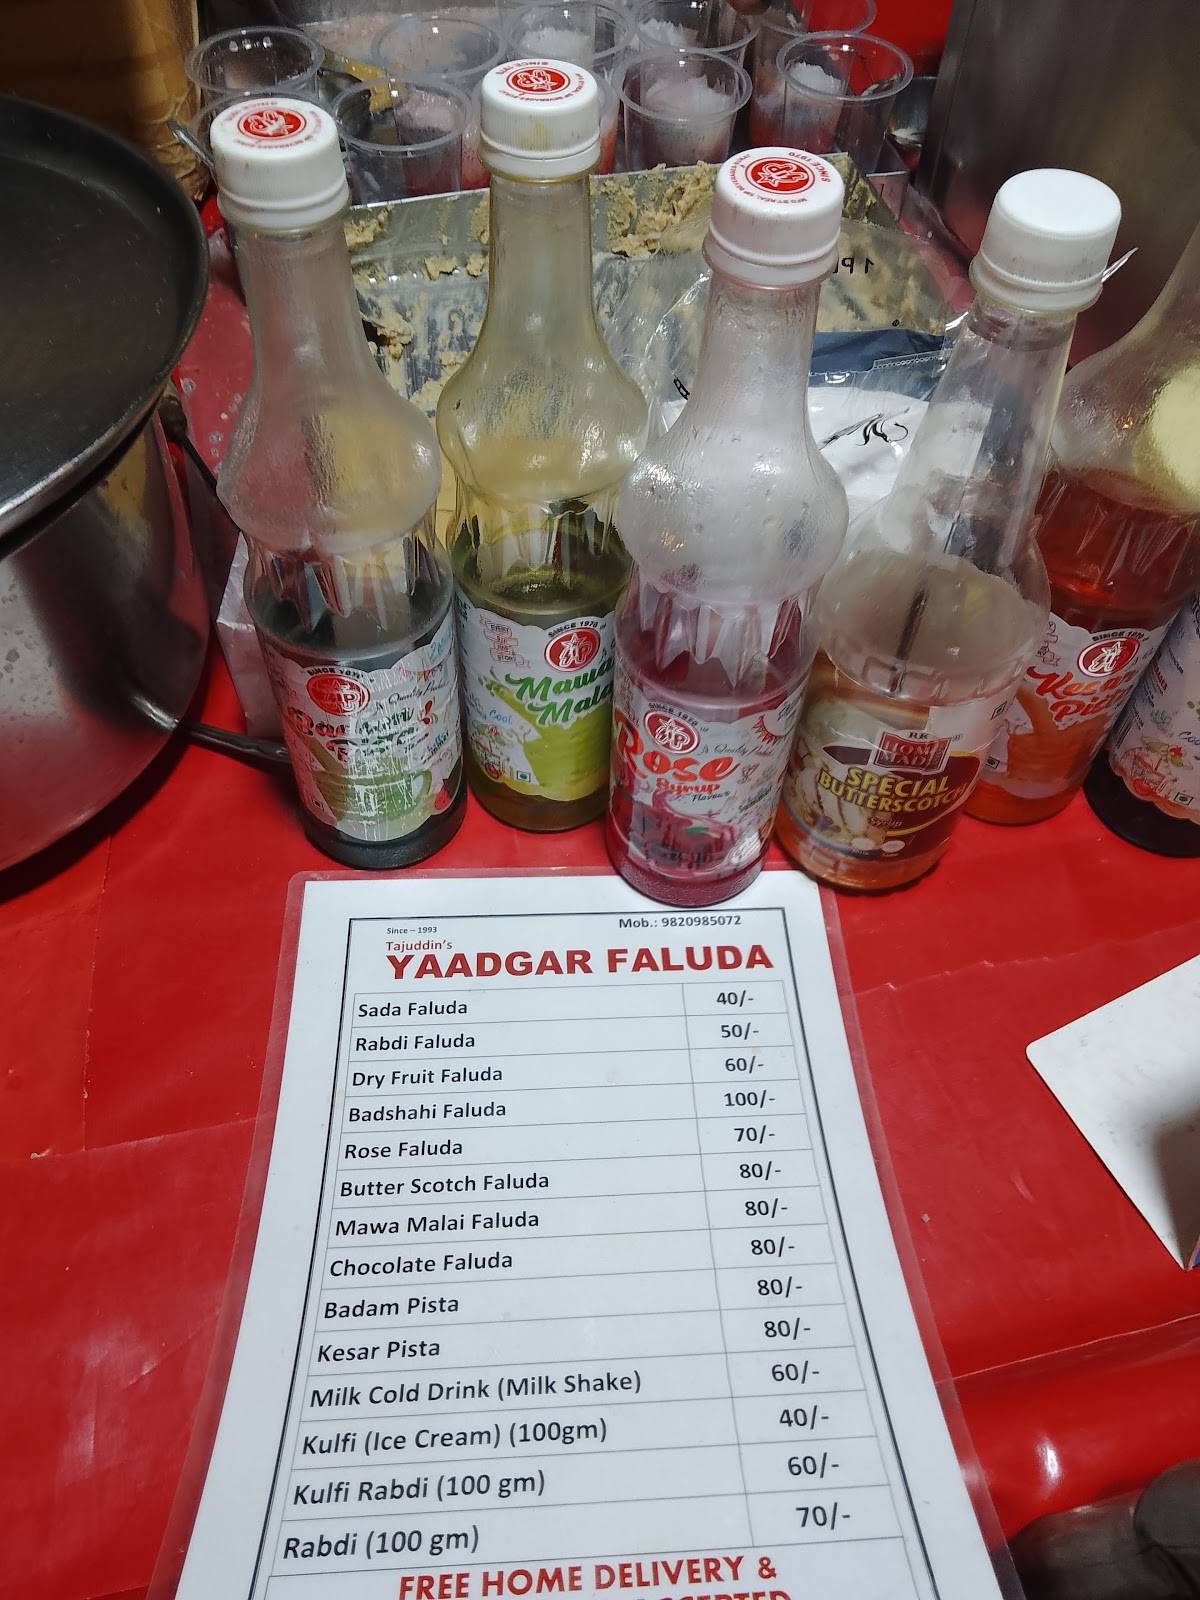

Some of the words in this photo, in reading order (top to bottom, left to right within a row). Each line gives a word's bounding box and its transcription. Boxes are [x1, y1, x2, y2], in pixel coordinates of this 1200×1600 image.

[788, 151, 812, 163] 1970
[812, 161, 831, 183] SINCE
[548, 623, 576, 637] SINCE
[614, 708, 741, 781] Rose
[847, 767, 949, 798] SPECIAL
[387, 927, 409, 935] Since
[418, 926, 438, 934] 1993
[619, 918, 657, 928] Mob.:
[662, 916, 741, 927] 9820985072
[388, 950, 591, 979] YAADGAR
[608, 945, 772, 972] FALUDA
[358, 1003, 400, 1017] Sada
[409, 1001, 467, 1015] Faluda
[717, 990, 753, 1007] 40/-
[356, 1036, 407, 1051] Rabdi
[415, 1034, 474, 1049] Faluda
[722, 1023, 758, 1040] 50/-
[353, 1073, 385, 1088] Dry
[392, 1070, 434, 1084] Fruit
[442, 1067, 502, 1082] Faluda
[726, 1056, 763, 1073] 60/-
[349, 1105, 436, 1121] Badshahi
[444, 1102, 505, 1118] Faluda
[725, 1090, 774, 1108] 100/-
[345, 1145, 391, 1159] Rose
[399, 1140, 462, 1156] Faluda
[734, 1125, 774, 1144] 70/-
[341, 1182, 404, 1196] Butter
[411, 1176, 475, 1193] Scotch
[484, 1173, 548, 1190] Faluda
[740, 1161, 780, 1180] 80/-
[336, 1220, 398, 1236] Mawa
[408, 1215, 464, 1232] Malai
[473, 1211, 538, 1229] Faluda
[745, 1198, 787, 1218] 80/-
[331, 1257, 435, 1276] Chocolate
[444, 1252, 512, 1270] Faluda
[751, 1237, 794, 1257] 80/-
[325, 1300, 398, 1318] Badam
[408, 1297, 458, 1314] Pista
[758, 1277, 802, 1297] 80/-
[318, 1345, 379, 1362] Kesar
[387, 1340, 439, 1358] Pista
[764, 1318, 810, 1340] 80/-
[311, 1387, 361, 1407] Milk
[369, 1383, 419, 1404] Cold
[428, 1380, 489, 1400] Drink
[499, 1376, 556, 1401] (Milk
[565, 1371, 640, 1393] Shake)
[772, 1361, 819, 1384] 60/-
[303, 1433, 356, 1454] Kulfi
[365, 1431, 406, 1456] (Ice
[415, 1424, 500, 1448] Cream)
[510, 1418, 606, 1447] (100gm)
[780, 1405, 828, 1429] 40/-
[294, 1482, 349, 1505] Kulfi
[358, 1478, 428, 1501] Rabdi
[438, 1475, 490, 1501] (100
[498, 1470, 544, 1498] gm)
[788, 1453, 838, 1478] 60/-
[284, 1533, 357, 1559] Rabdi
[367, 1530, 421, 1559] (100
[430, 1525, 478, 1555] gm)
[796, 1503, 850, 1530] 70/-
[400, 1572, 468, 1600] FREE
[483, 1568, 580, 1596] HOME
[596, 1557, 741, 1589] DELIVERY
[759, 1558, 775, 1579] &
